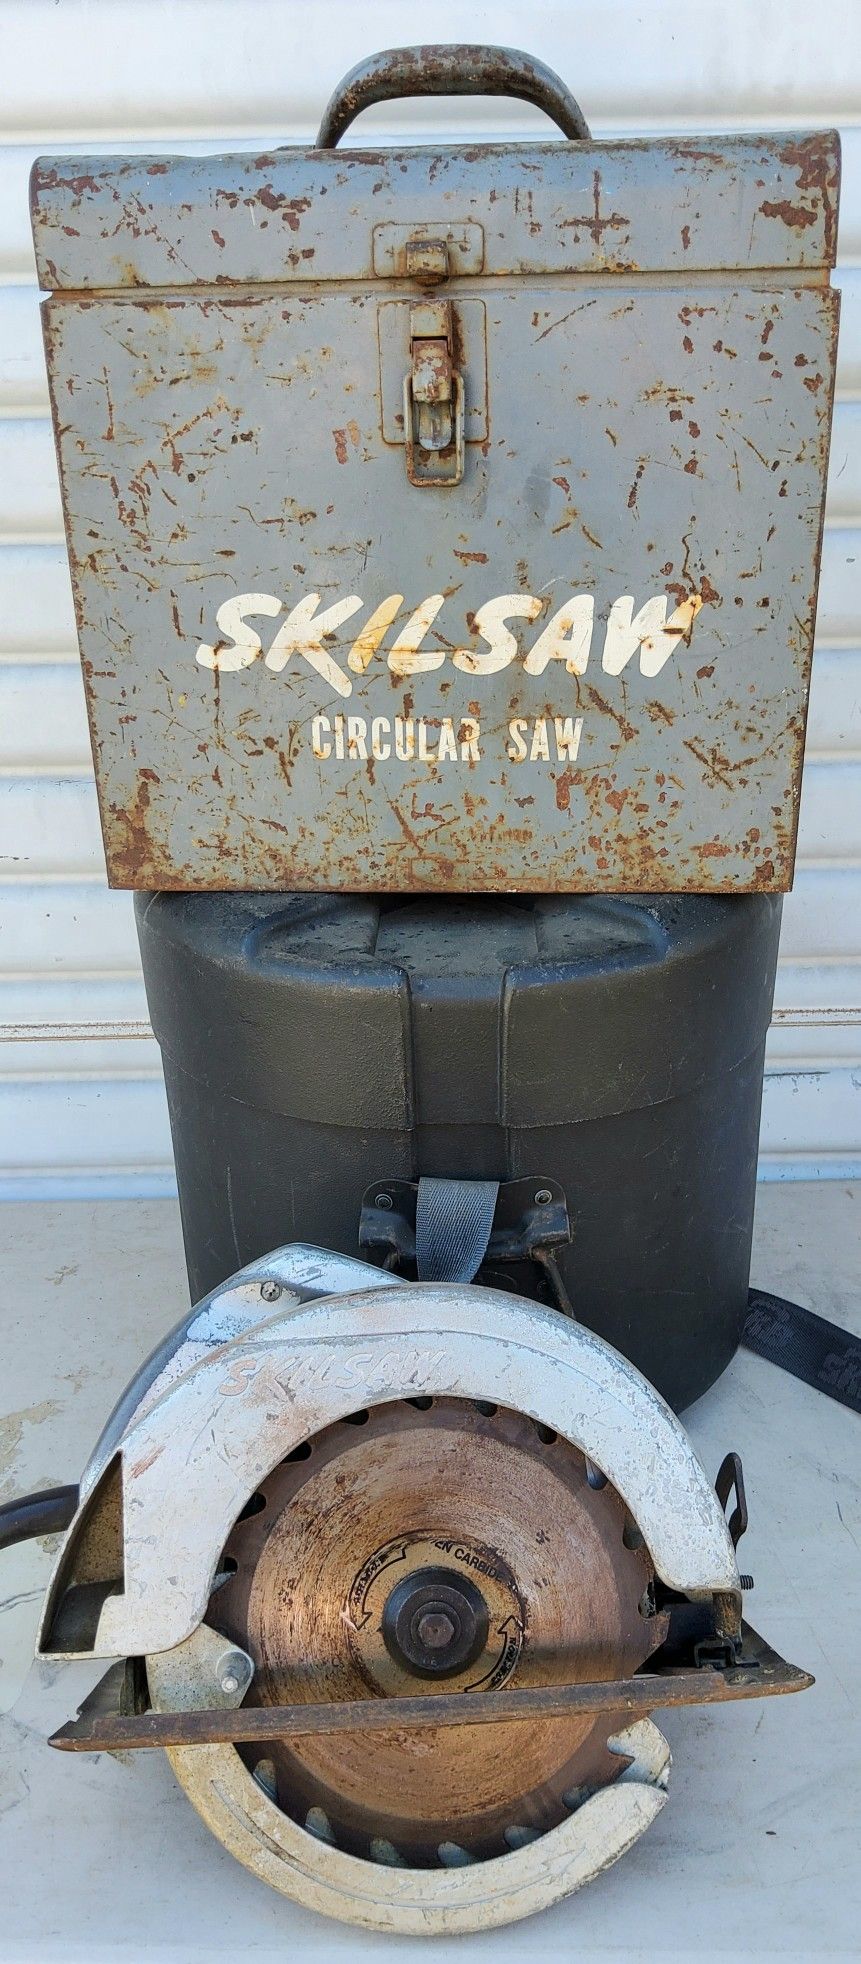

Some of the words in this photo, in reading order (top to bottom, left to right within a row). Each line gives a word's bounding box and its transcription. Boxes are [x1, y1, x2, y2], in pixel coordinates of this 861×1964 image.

[196, 593, 704, 698] SKILSAW
[311, 715, 481, 761] CIRCULAR
[508, 716, 585, 762] SAW
[219, 1350, 447, 1402] SKILSAW
